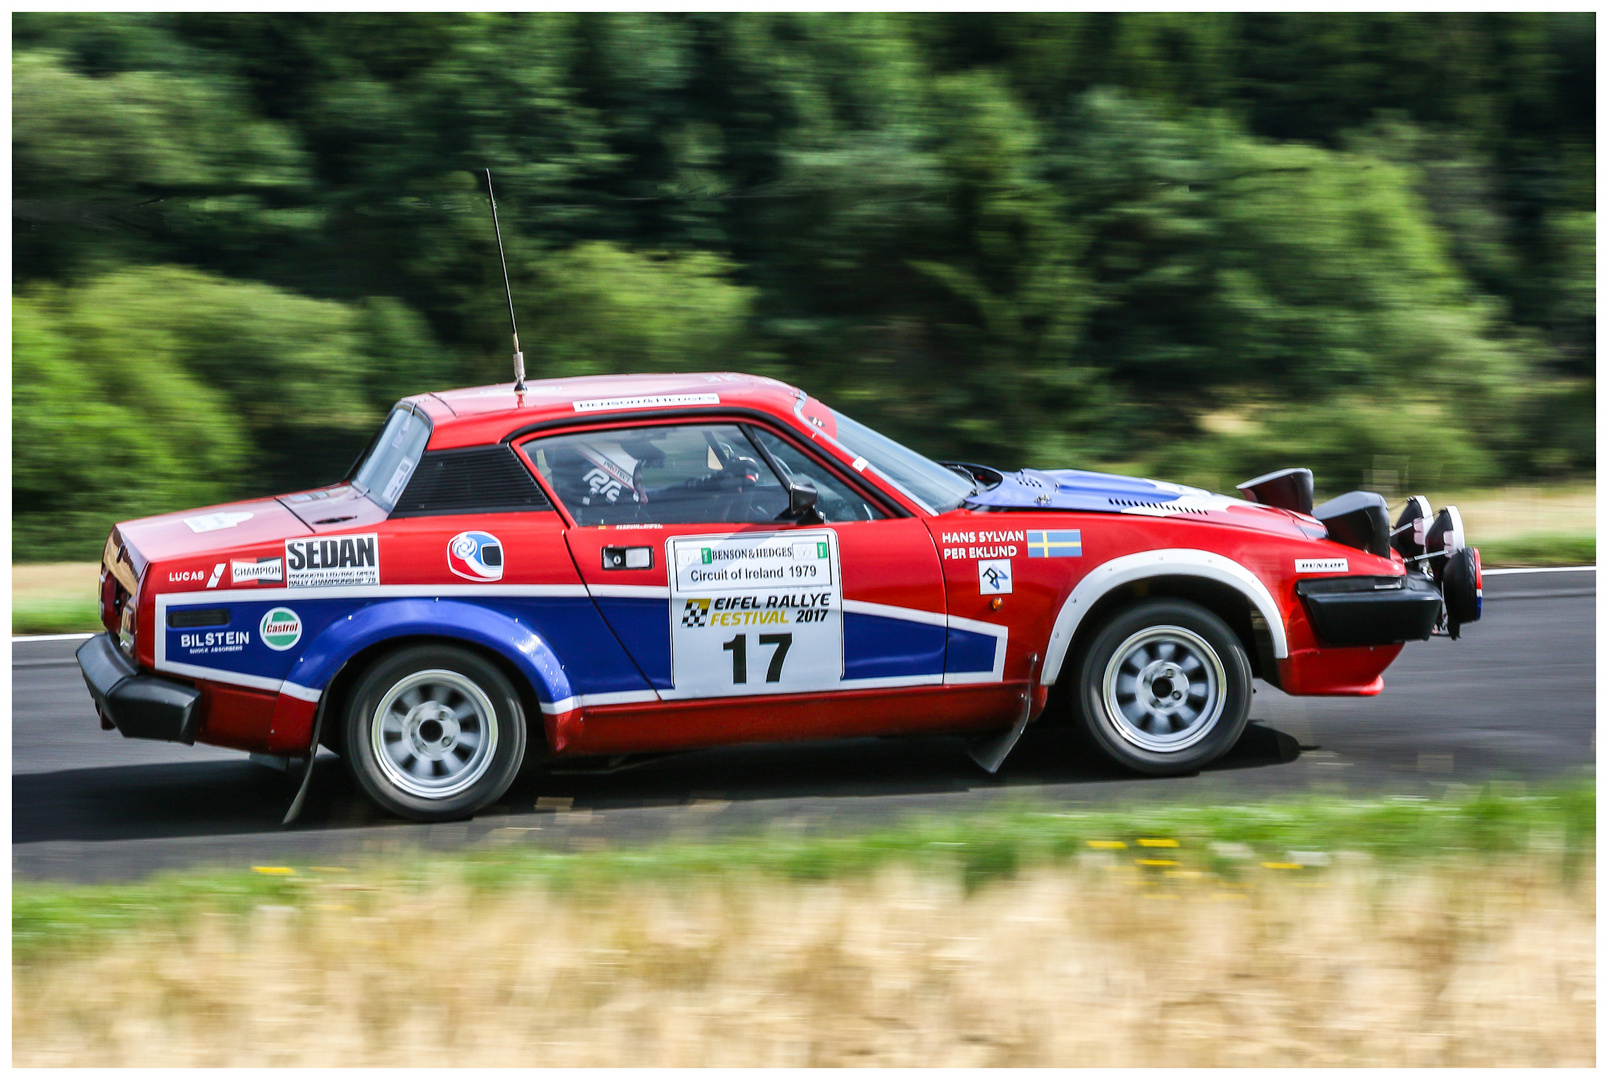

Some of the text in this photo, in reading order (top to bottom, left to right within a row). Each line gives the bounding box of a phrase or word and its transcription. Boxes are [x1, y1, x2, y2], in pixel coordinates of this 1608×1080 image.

[941, 530, 1025, 544] HANS SYLVAN
[287, 537, 375, 570] SEDAN
[943, 545, 1018, 560] PER EKLUND
[169, 570, 205, 582] LUCAS
[234, 565, 281, 577] CHAMPION
[690, 565, 817, 582] Circuit of Ireland 1979
[714, 592, 832, 610] EIFEL RALLYE
[709, 609, 829, 627] FESTIVAL 2017
[266, 622, 299, 634] Castrol
[180, 631, 250, 648] BILSTEIN
[189, 647, 209, 655] SHOCK
[722, 632, 793, 685] 17
